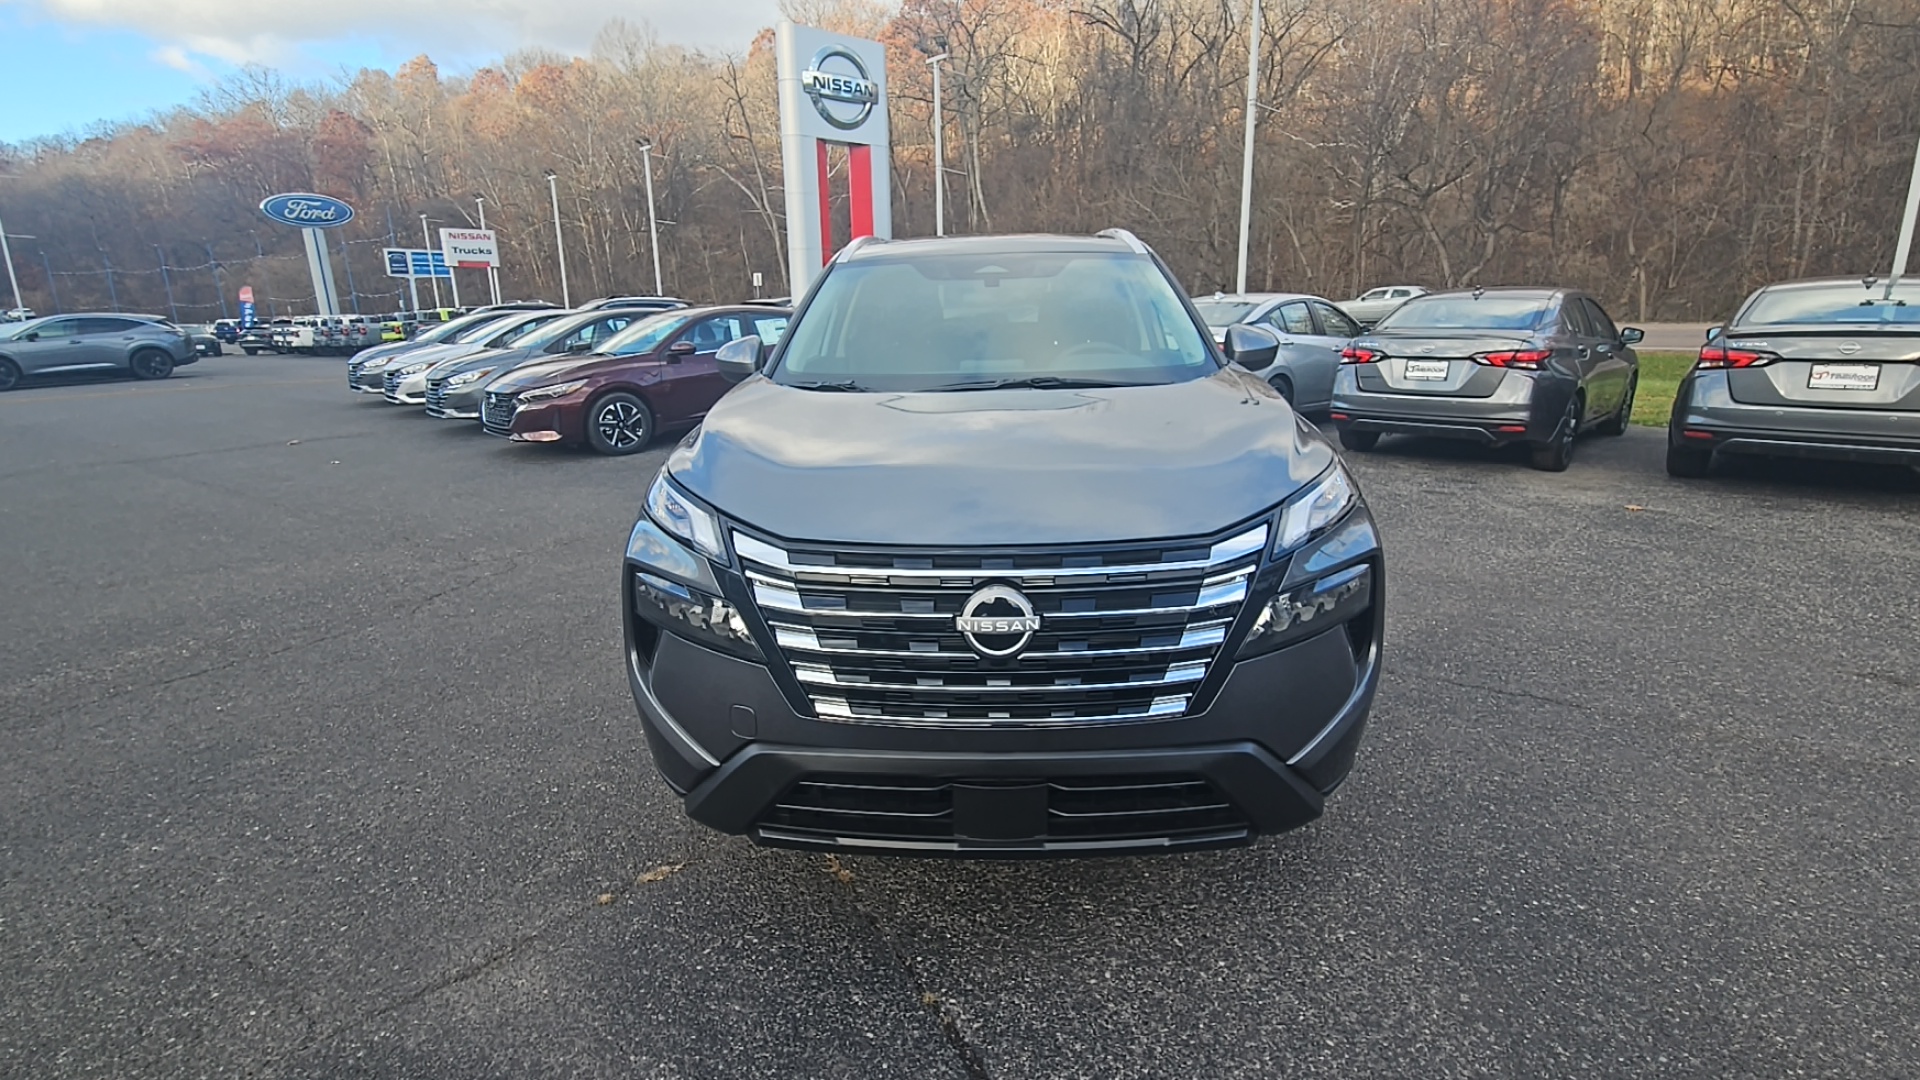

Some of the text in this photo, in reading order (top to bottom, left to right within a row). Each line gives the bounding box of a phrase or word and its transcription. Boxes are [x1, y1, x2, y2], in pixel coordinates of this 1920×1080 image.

[812, 75, 873, 98] NISSAN
[284, 199, 336, 220] Ford
[448, 232, 492, 241] NISSAN
[451, 246, 493, 255] Trucks
[958, 619, 1040, 632] NISSAN
